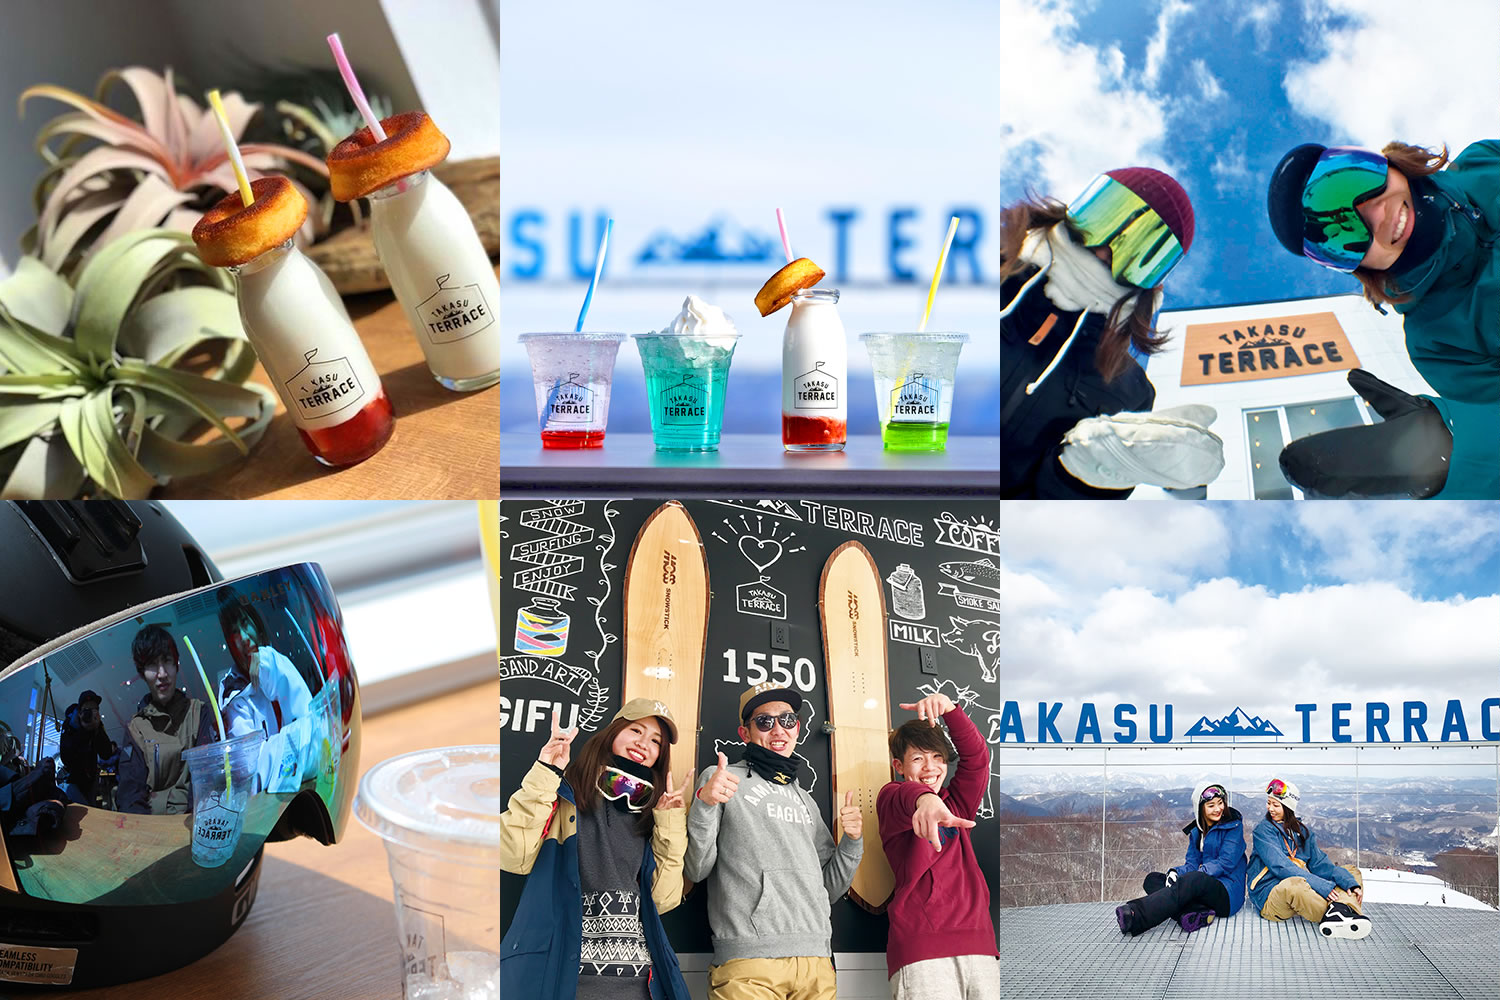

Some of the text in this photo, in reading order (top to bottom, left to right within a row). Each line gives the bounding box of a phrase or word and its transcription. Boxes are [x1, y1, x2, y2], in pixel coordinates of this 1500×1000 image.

[508, 208, 608, 282] SU
[431, 299, 469, 317] TAKASU
[429, 304, 486, 333] TERRACE
[1219, 324, 1306, 345] TAKASU
[1198, 340, 1344, 376] TERRACE
[301, 373, 338, 392] TKASU
[803, 380, 829, 389] TAKASU
[299, 377, 355, 409] TERRACE
[556, 393, 584, 402] TAKASU
[669, 394, 699, 404] TAKASU
[798, 391, 835, 401] TERRACE
[900, 393, 928, 403] TAKASU
[551, 404, 590, 414] TERRACE
[664, 406, 705, 417] TERRACE
[894, 404, 935, 415] TERRACE
[530, 506, 576, 520] SNOW
[800, 500, 925, 547] TERRACE
[520, 533, 581, 556] SURFING
[522, 563, 572, 584] ENJOY
[748, 589, 777, 599] TAKASU
[958, 595, 984, 608] SMOKE
[663, 587, 671, 630] SNOWSTICK
[741, 598, 781, 613] TERRACE
[893, 623, 935, 645] MILK
[500, 658, 579, 686] SAND ART
[722, 648, 817, 692] 1550
[1000, 701, 1174, 744] AKASU
[1295, 697, 1500, 744] TERRAC
